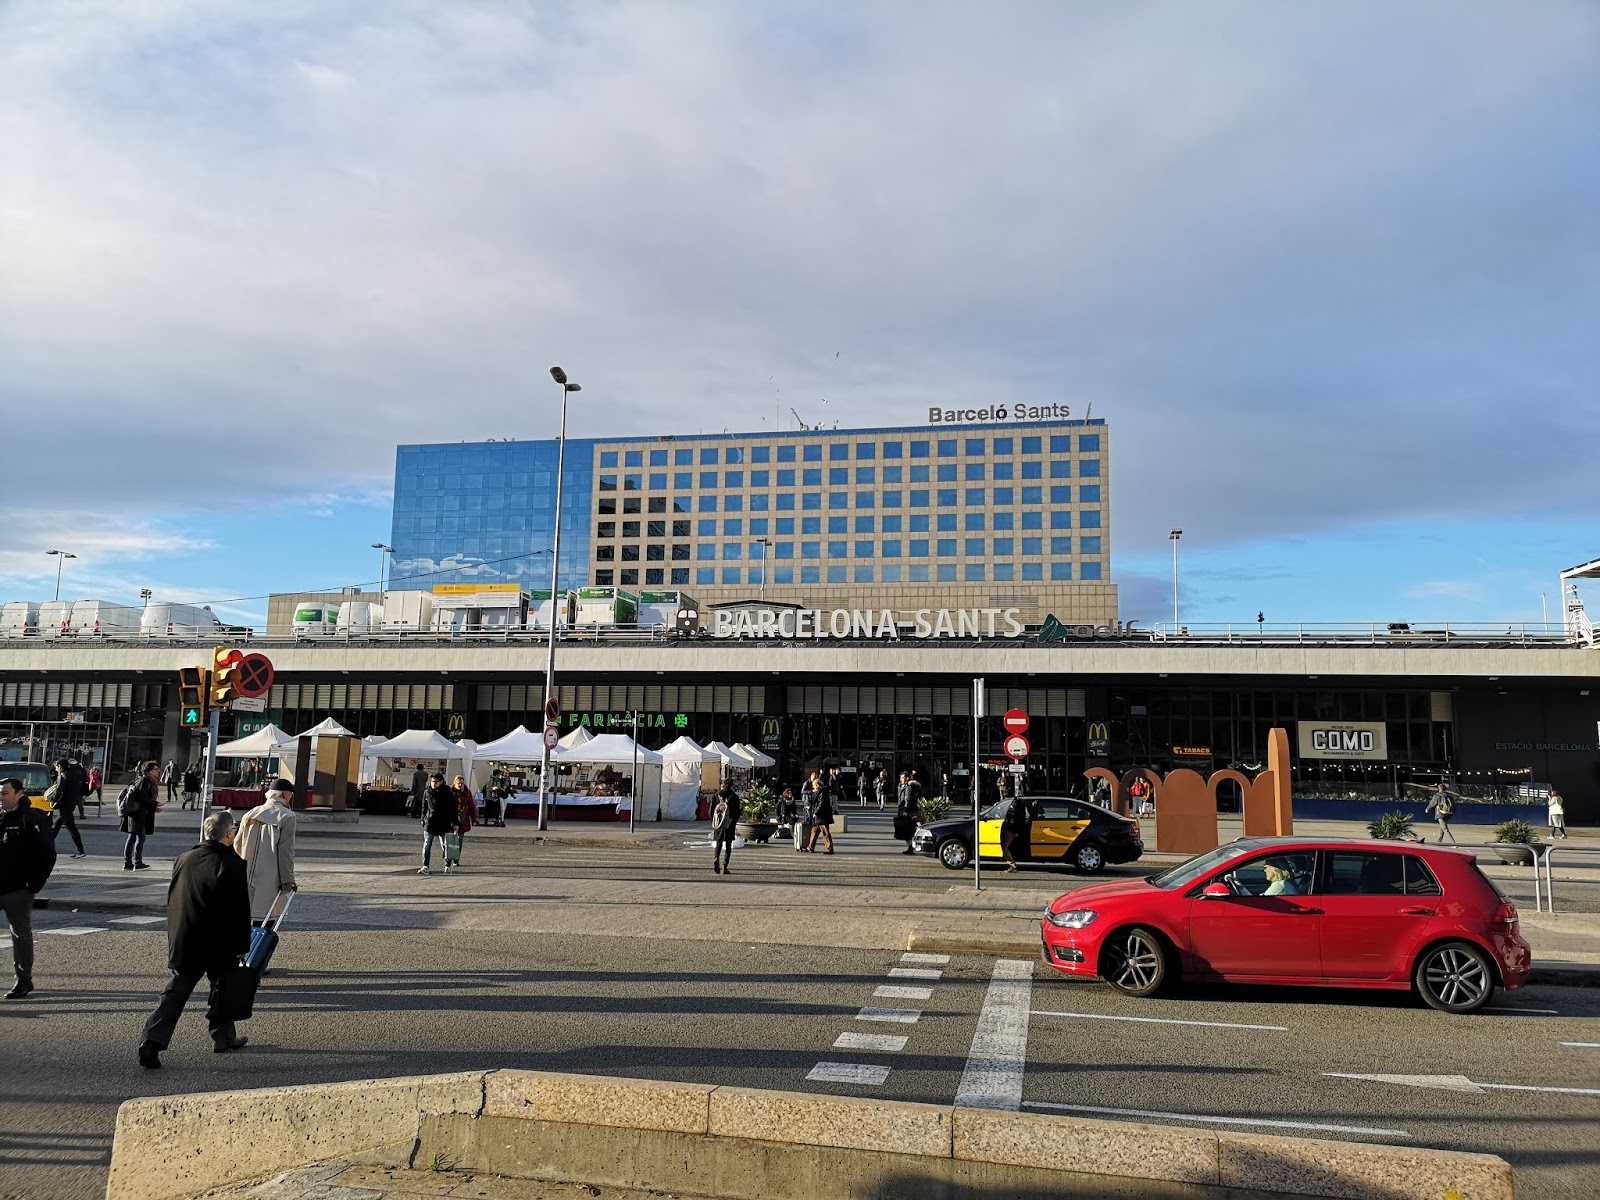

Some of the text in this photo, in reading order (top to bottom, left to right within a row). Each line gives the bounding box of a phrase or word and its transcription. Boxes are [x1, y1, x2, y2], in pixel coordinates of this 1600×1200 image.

[929, 403, 1070, 423] Barceló Sants
[1073, 619, 1139, 638] adif
[1312, 730, 1374, 751] COMO
[1536, 743, 1590, 751] BARCELONA
